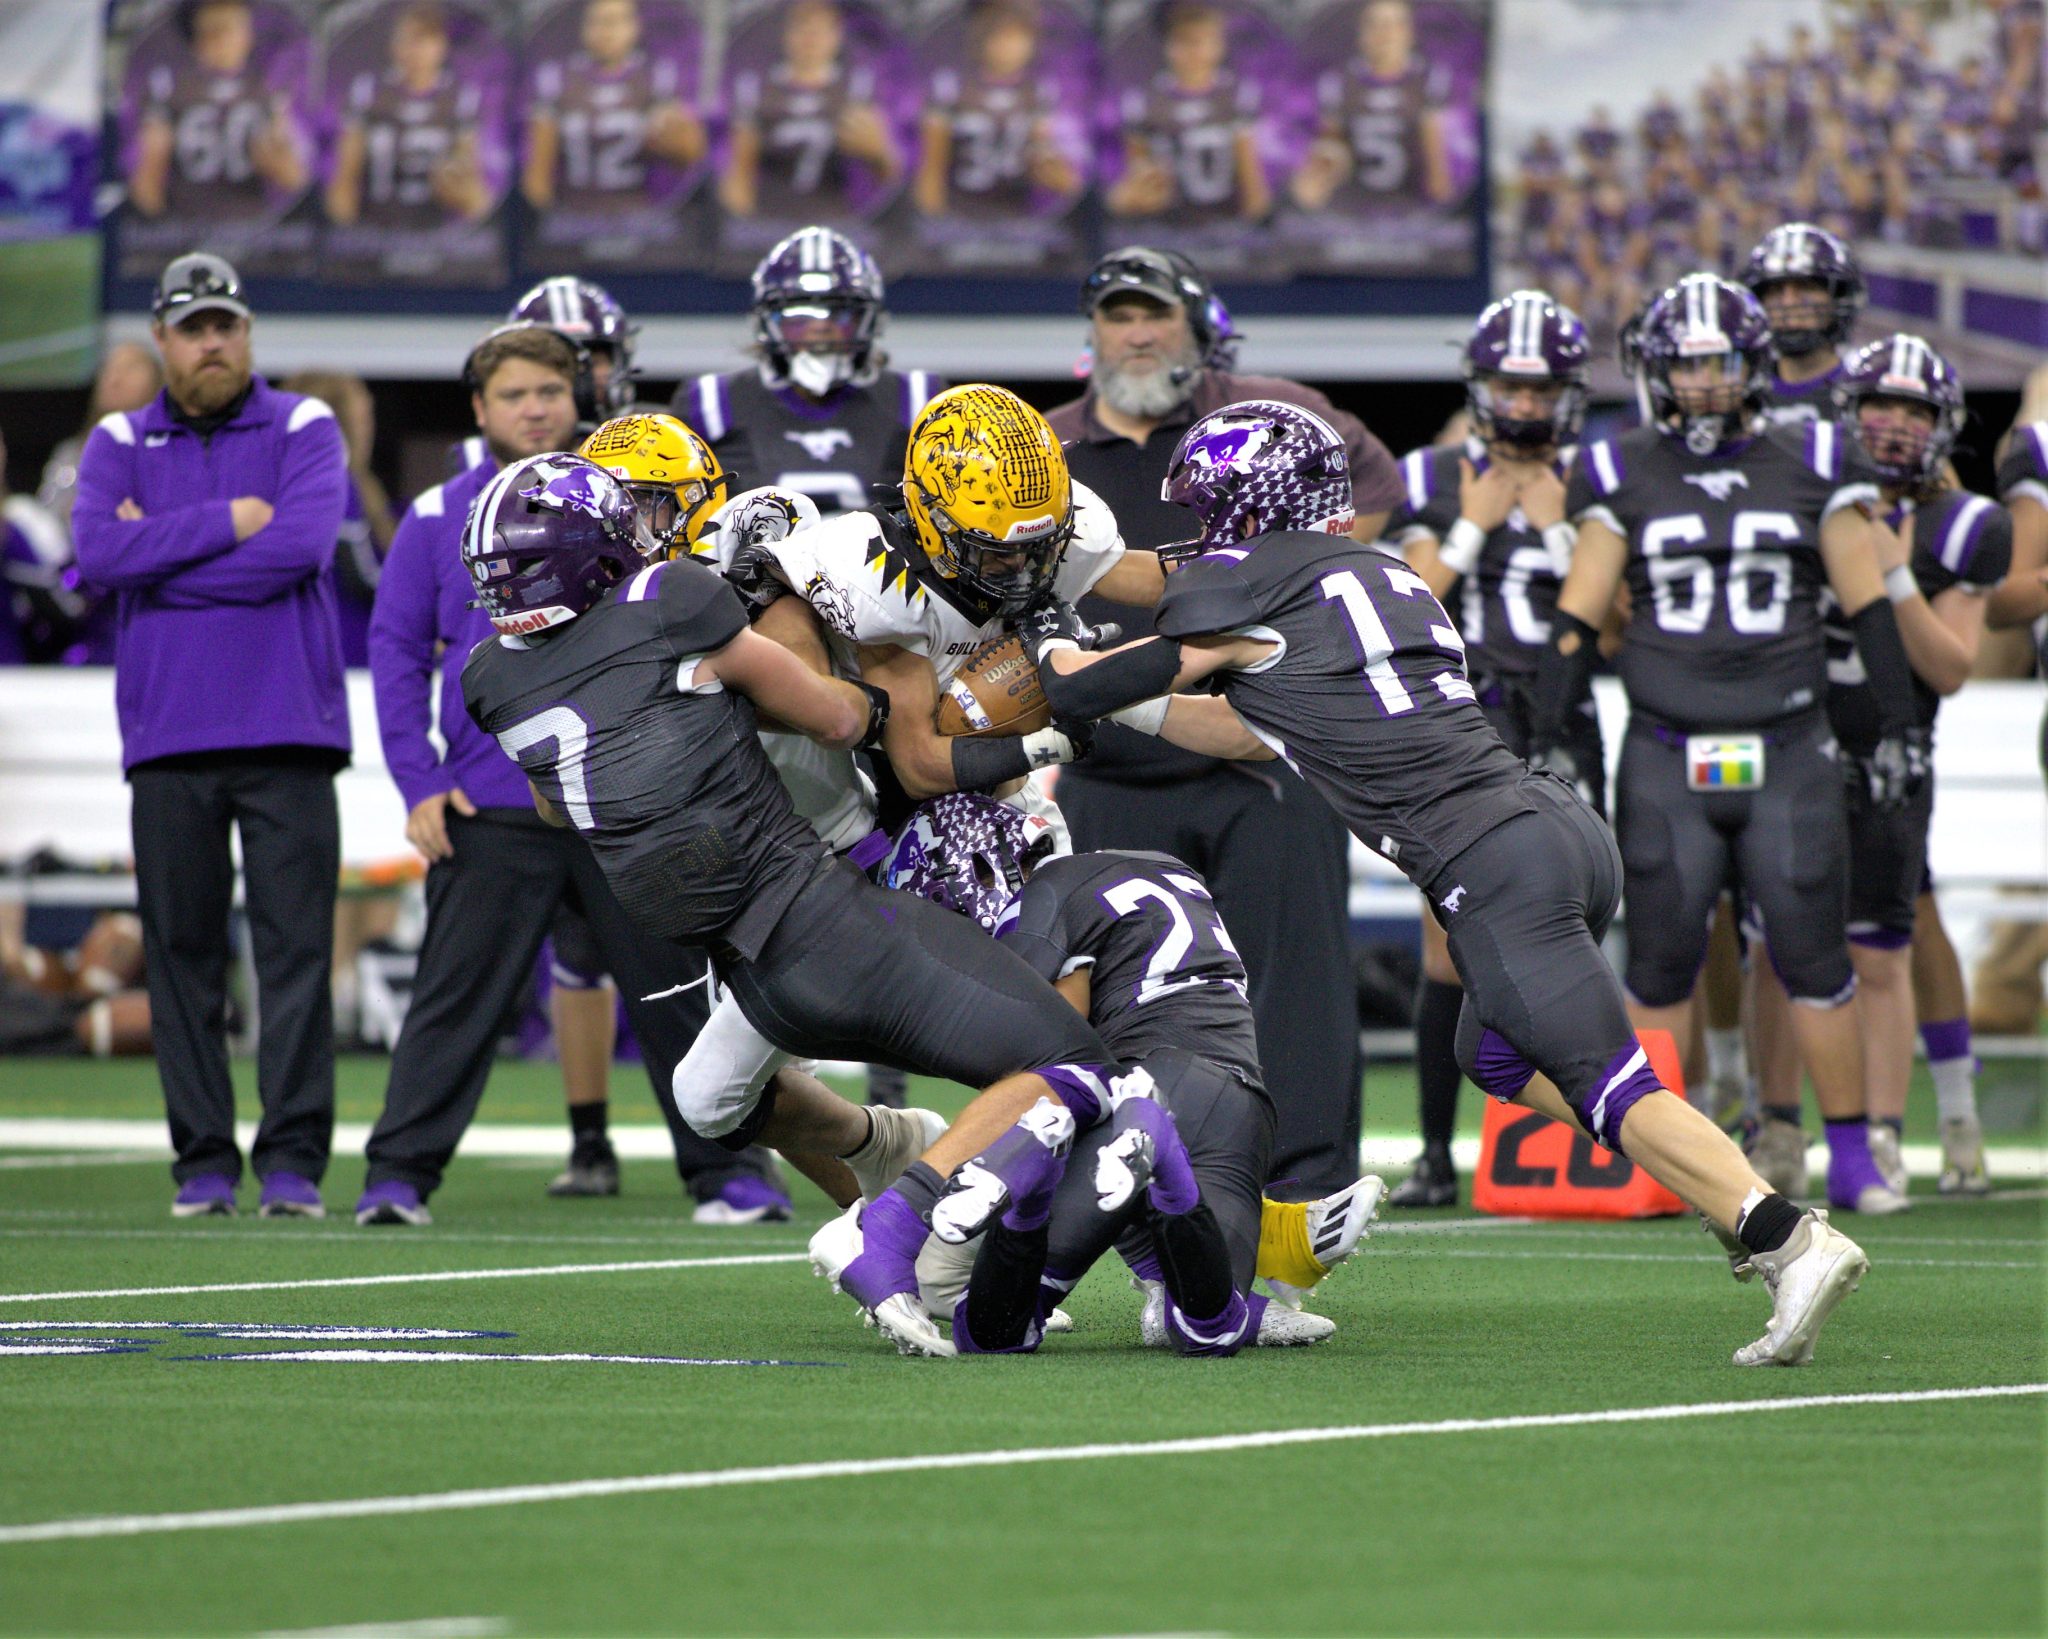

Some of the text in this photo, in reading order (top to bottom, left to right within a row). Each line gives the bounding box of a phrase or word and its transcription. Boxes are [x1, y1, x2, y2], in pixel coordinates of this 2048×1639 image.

[562, 109, 648, 190] 12
[772, 119, 834, 195] 7
[1351, 114, 1407, 189] 5
[1016, 519, 1052, 534] Riddell
[1642, 511, 1801, 634] 66
[497, 706, 596, 830] 7
